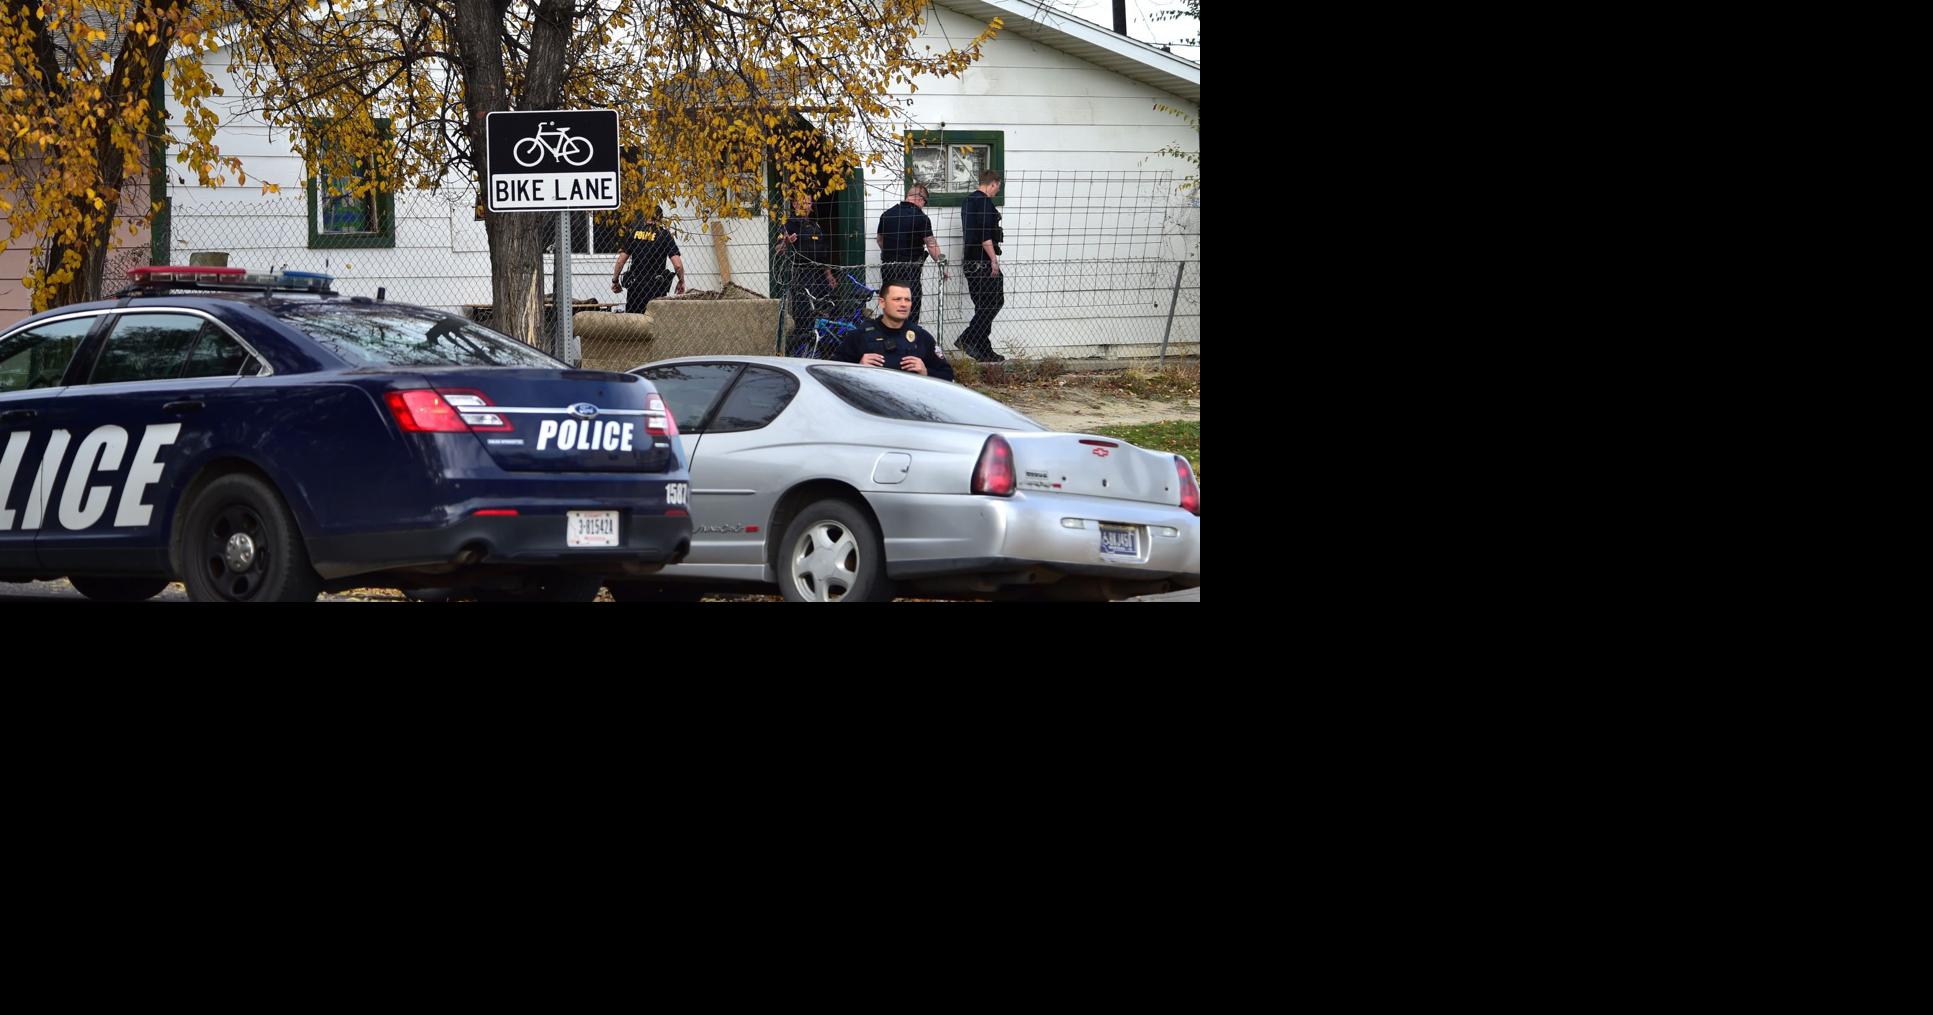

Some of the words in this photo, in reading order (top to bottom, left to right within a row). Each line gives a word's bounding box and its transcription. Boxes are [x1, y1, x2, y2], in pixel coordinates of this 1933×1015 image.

[496, 179, 545, 202] BIKE
[554, 178, 613, 201] LANE
[633, 230, 657, 241] POLIE
[536, 419, 634, 452] POLICE
[665, 483, 687, 505] 1587
